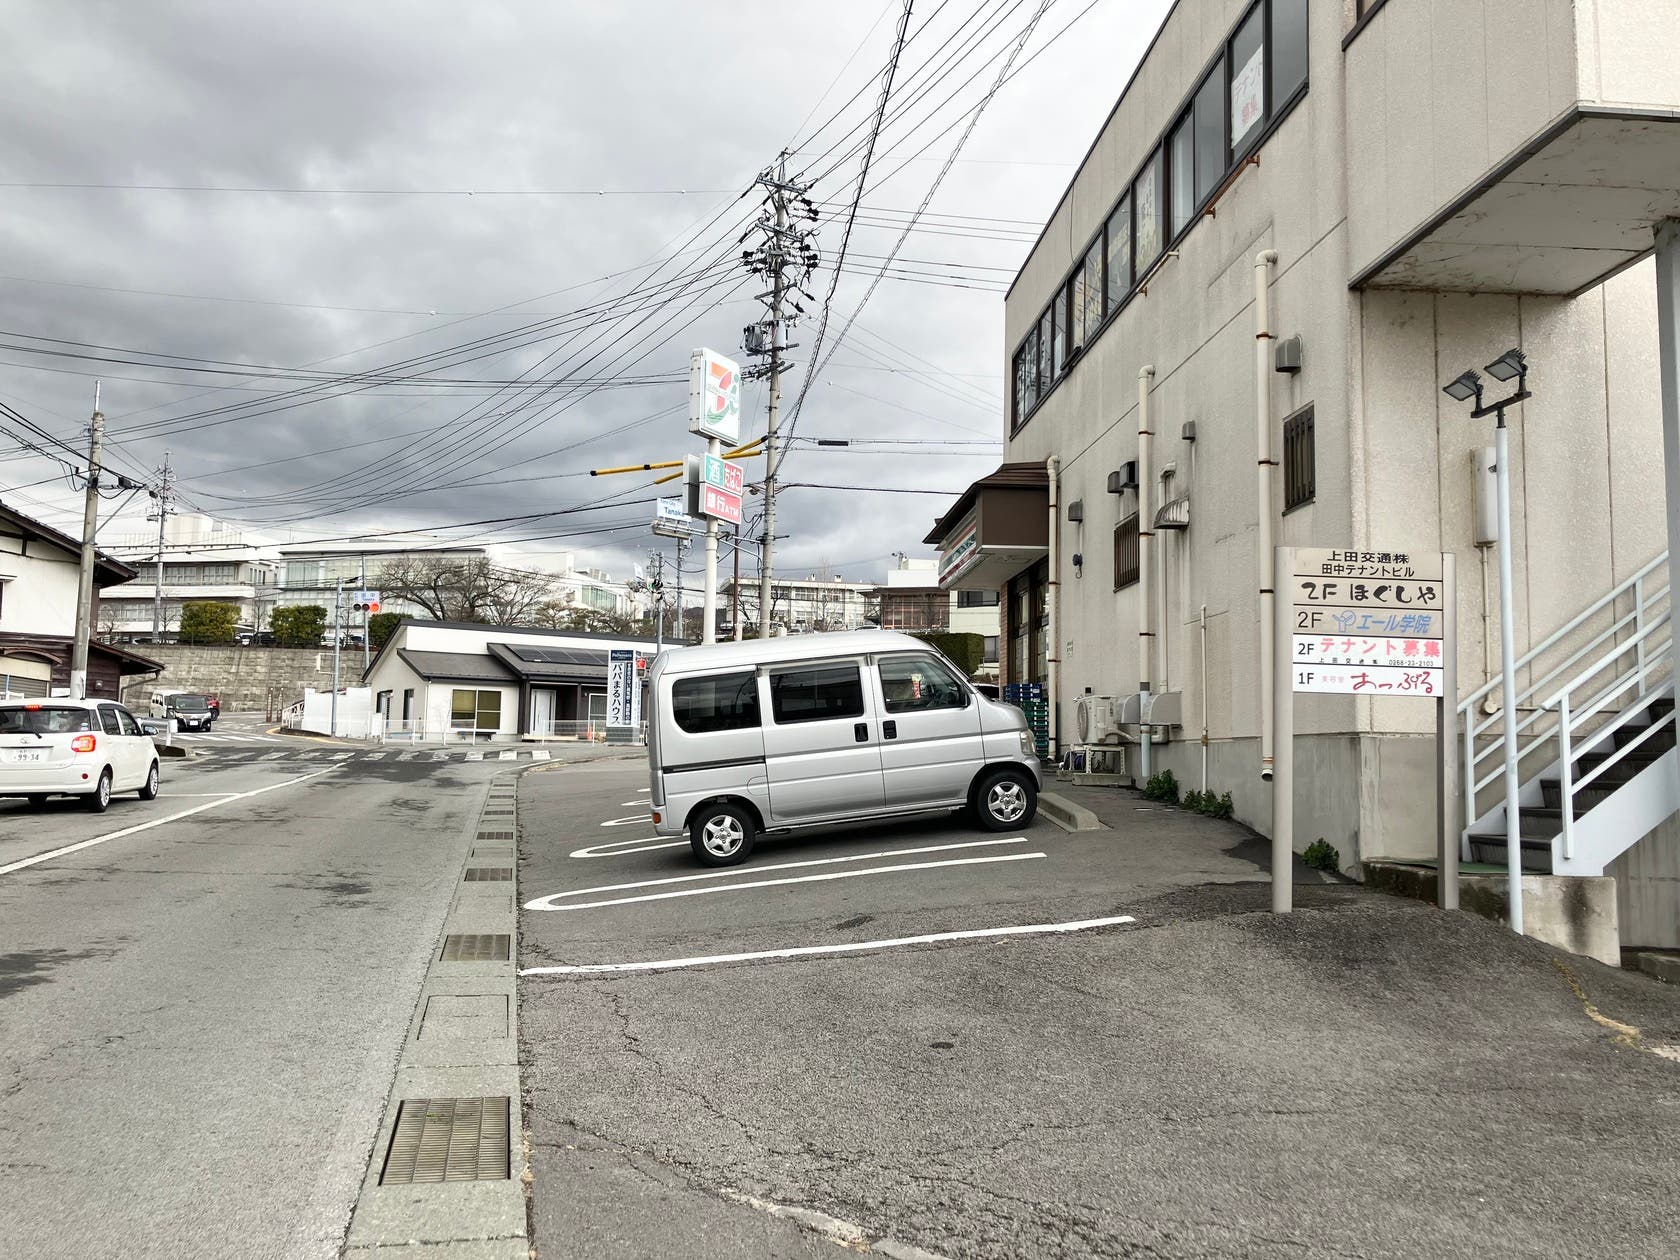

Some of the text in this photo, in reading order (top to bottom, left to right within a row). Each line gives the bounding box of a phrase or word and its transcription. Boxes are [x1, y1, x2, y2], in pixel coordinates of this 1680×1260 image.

[1322, 563, 1414, 577] 田中テナントビル
[1301, 582, 1436, 604] 2F ほぐしや
[1298, 611, 1432, 634] 2F エール学院
[1298, 638, 1440, 657] 2F テナント募集
[1299, 672, 1314, 684] 1F
[1350, 671, 1433, 693] あっぷる
[612, 663, 623, 724] パパまるハウス
